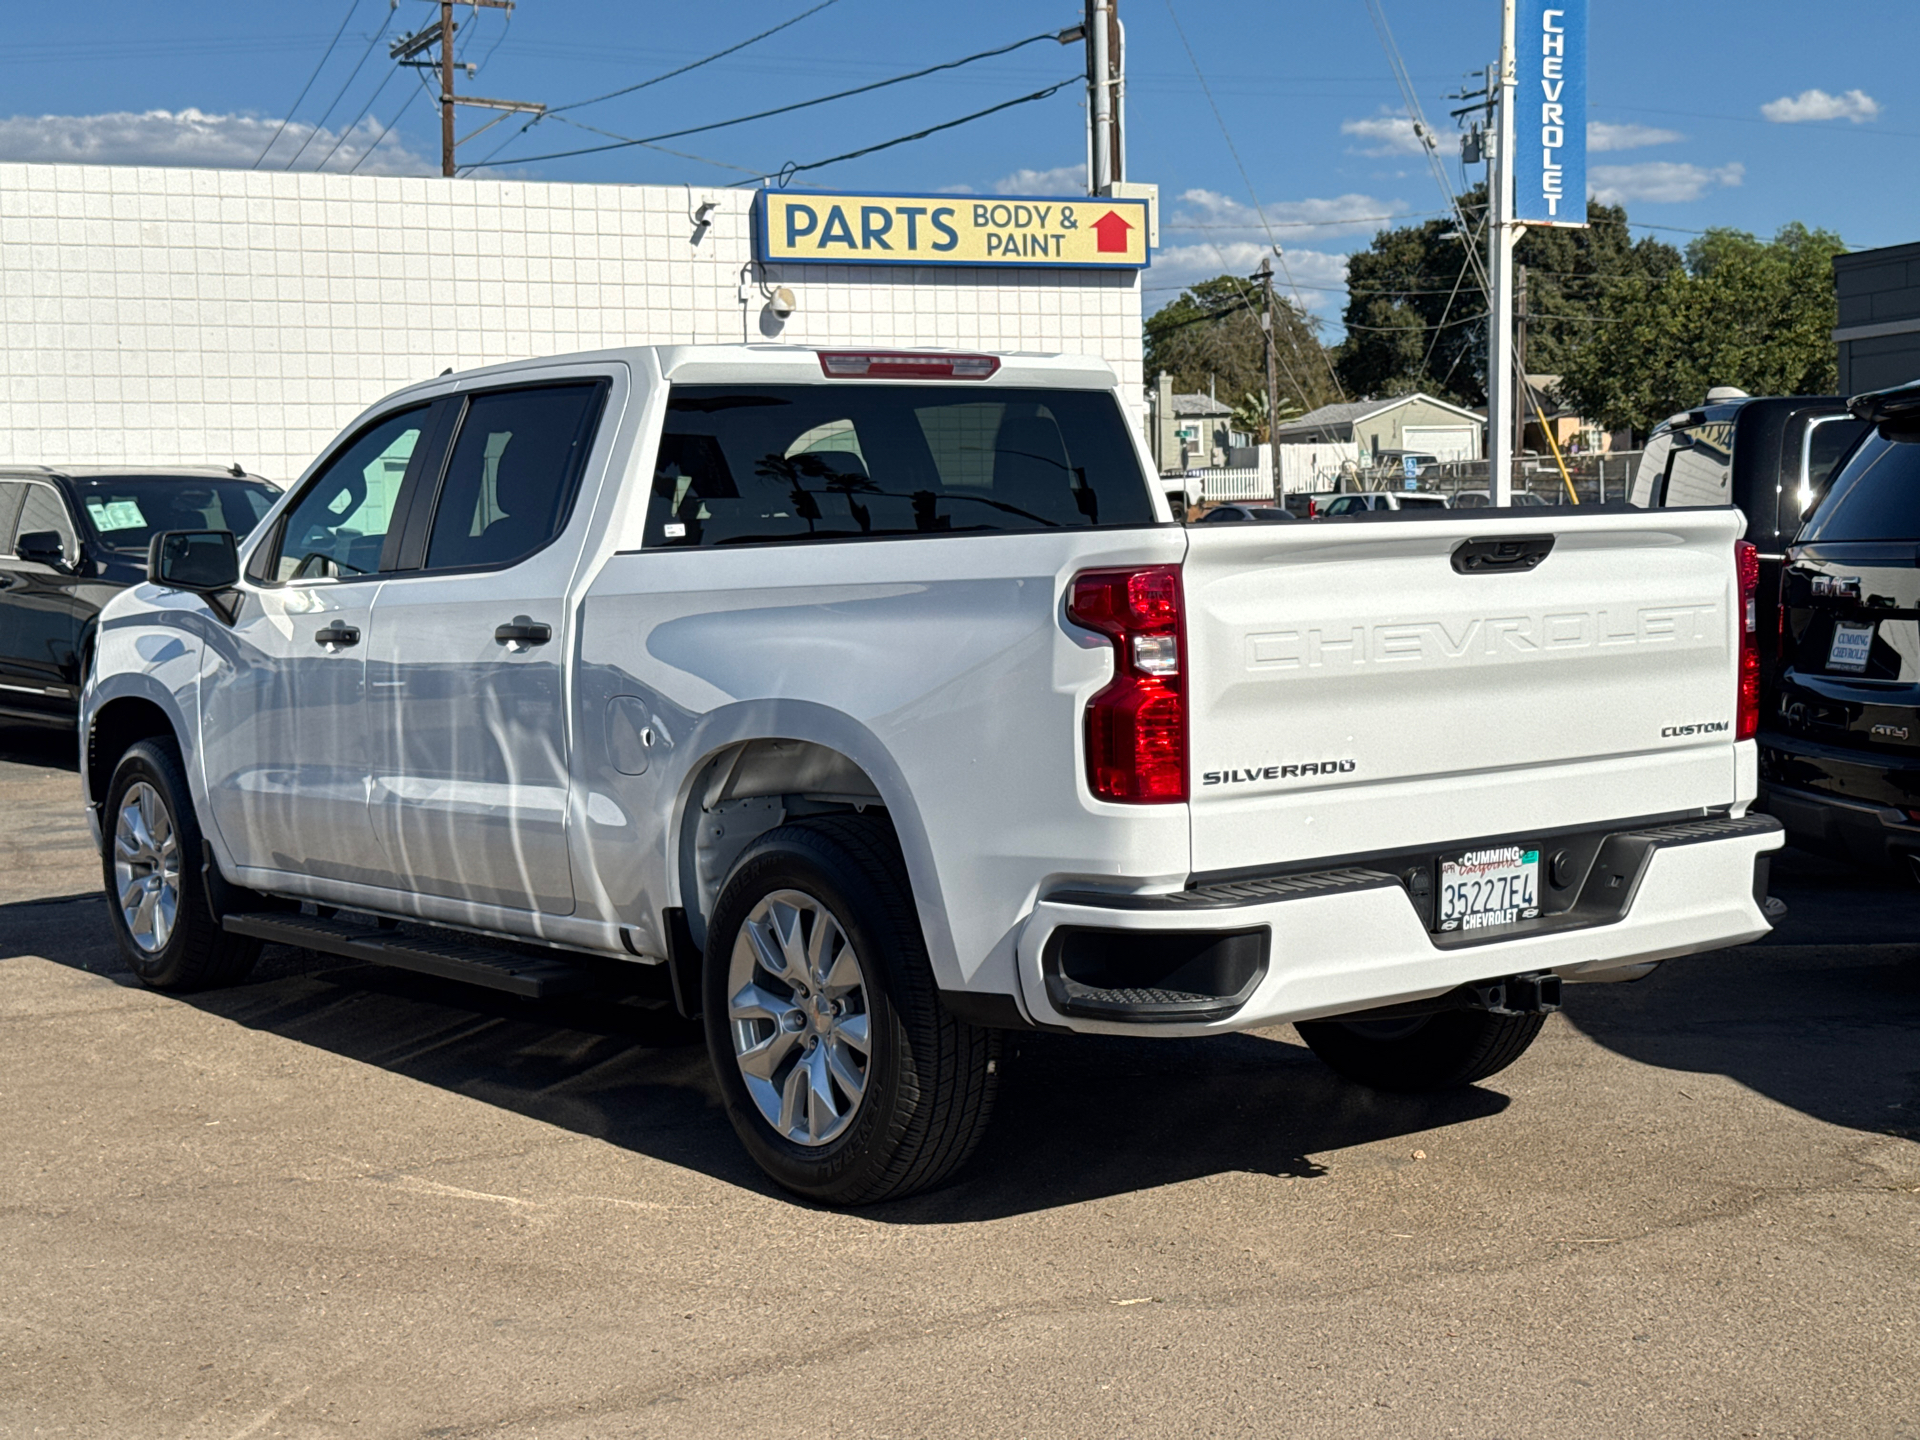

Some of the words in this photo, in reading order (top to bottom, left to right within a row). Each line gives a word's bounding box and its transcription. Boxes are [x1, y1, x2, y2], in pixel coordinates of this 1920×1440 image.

[1541, 9, 1565, 216] CHEVROLET
[785, 203, 959, 252] PARTS
[973, 204, 1052, 229] BODY
[1060, 206, 1079, 230] &
[986, 233, 1066, 257] PAINT
[1812, 576, 1861, 597] GMC
[1245, 603, 1717, 671] CHEVROLET
[1838, 633, 1869, 646] CUMMING
[1832, 646, 1868, 660] CHEVROLET
[1661, 720, 1729, 738] CUSTOM
[1871, 724, 1909, 740] AT4
[1203, 759, 1357, 785] SILVERADO
[1463, 846, 1520, 867] CUMMING
[1442, 863, 1456, 875] APR
[1443, 873, 1534, 919] 35227E4
[1462, 908, 1519, 931] CHEVROLET
